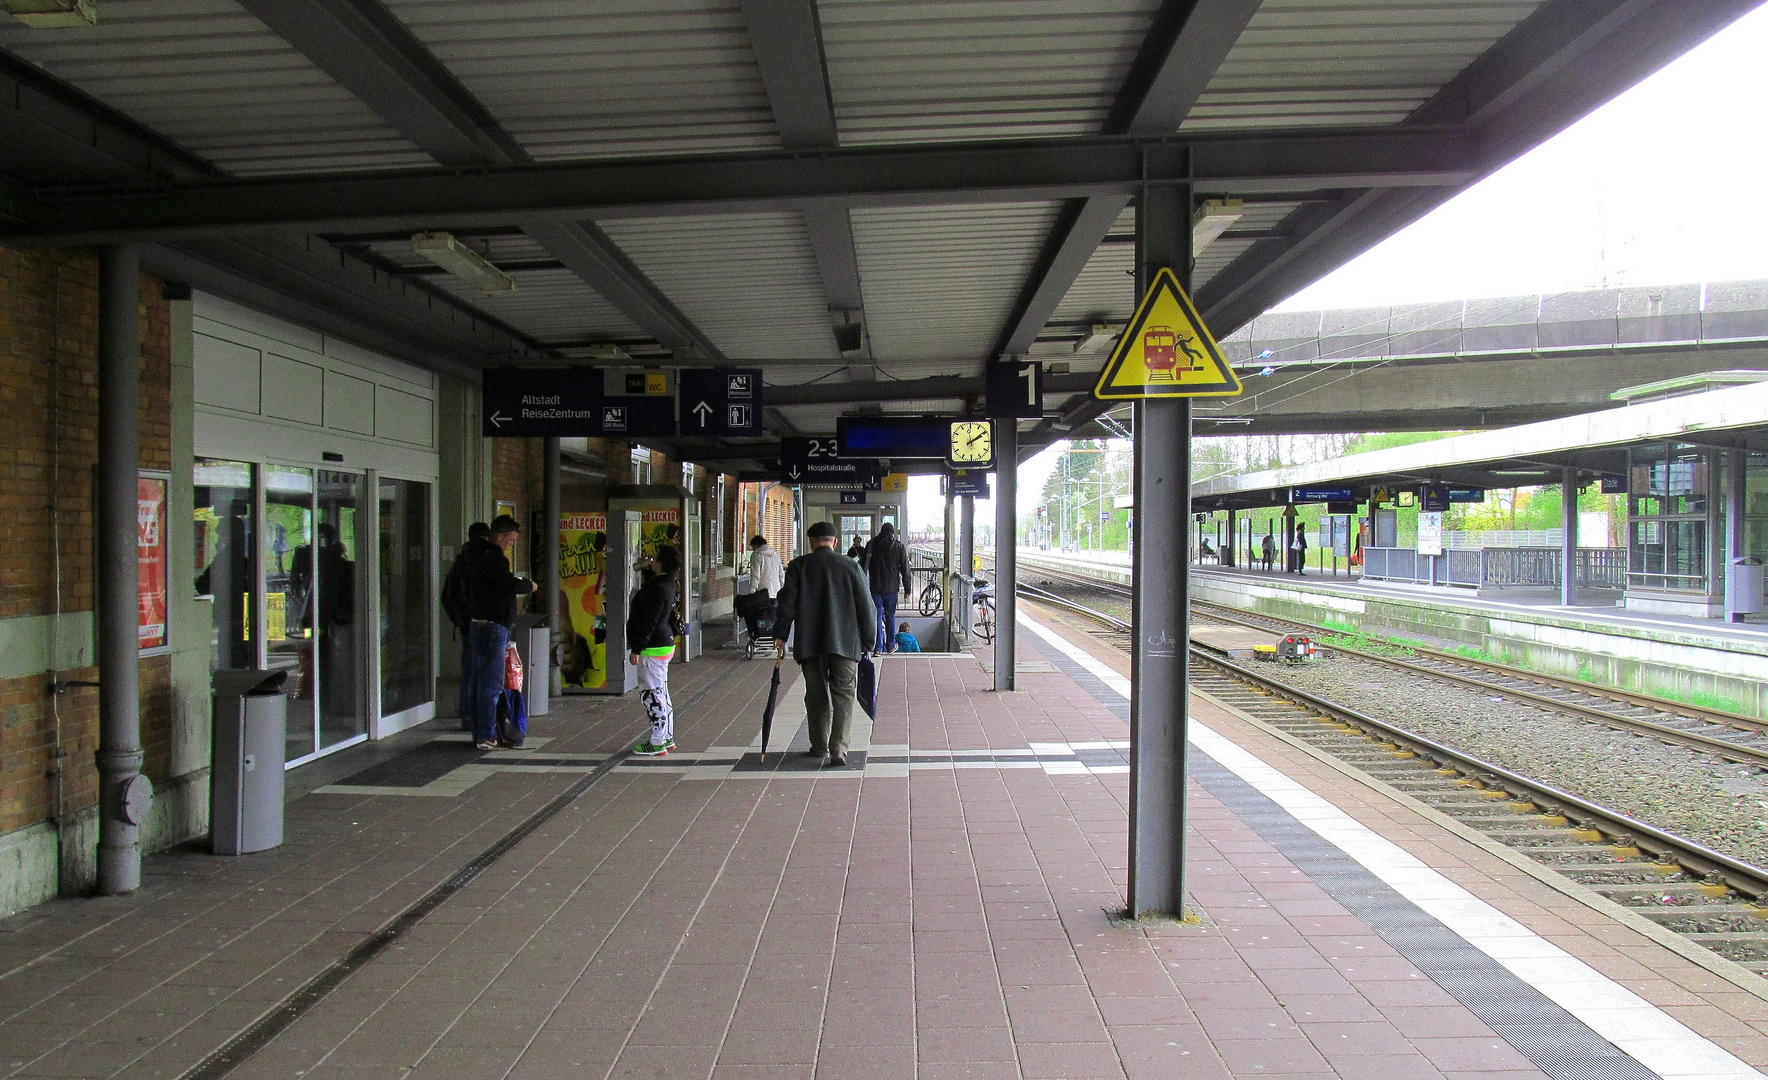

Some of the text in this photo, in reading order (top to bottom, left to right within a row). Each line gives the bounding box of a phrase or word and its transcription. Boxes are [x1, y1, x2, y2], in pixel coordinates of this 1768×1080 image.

[648, 383, 662, 391] WC
[1018, 364, 1036, 406] 1
[521, 394, 561, 405] Altstadt
[521, 408, 591, 419] ReiseZentrum
[807, 464, 856, 473] Hospitalstraße
[651, 511, 677, 522] LECKER
[575, 516, 606, 530] LECKER
